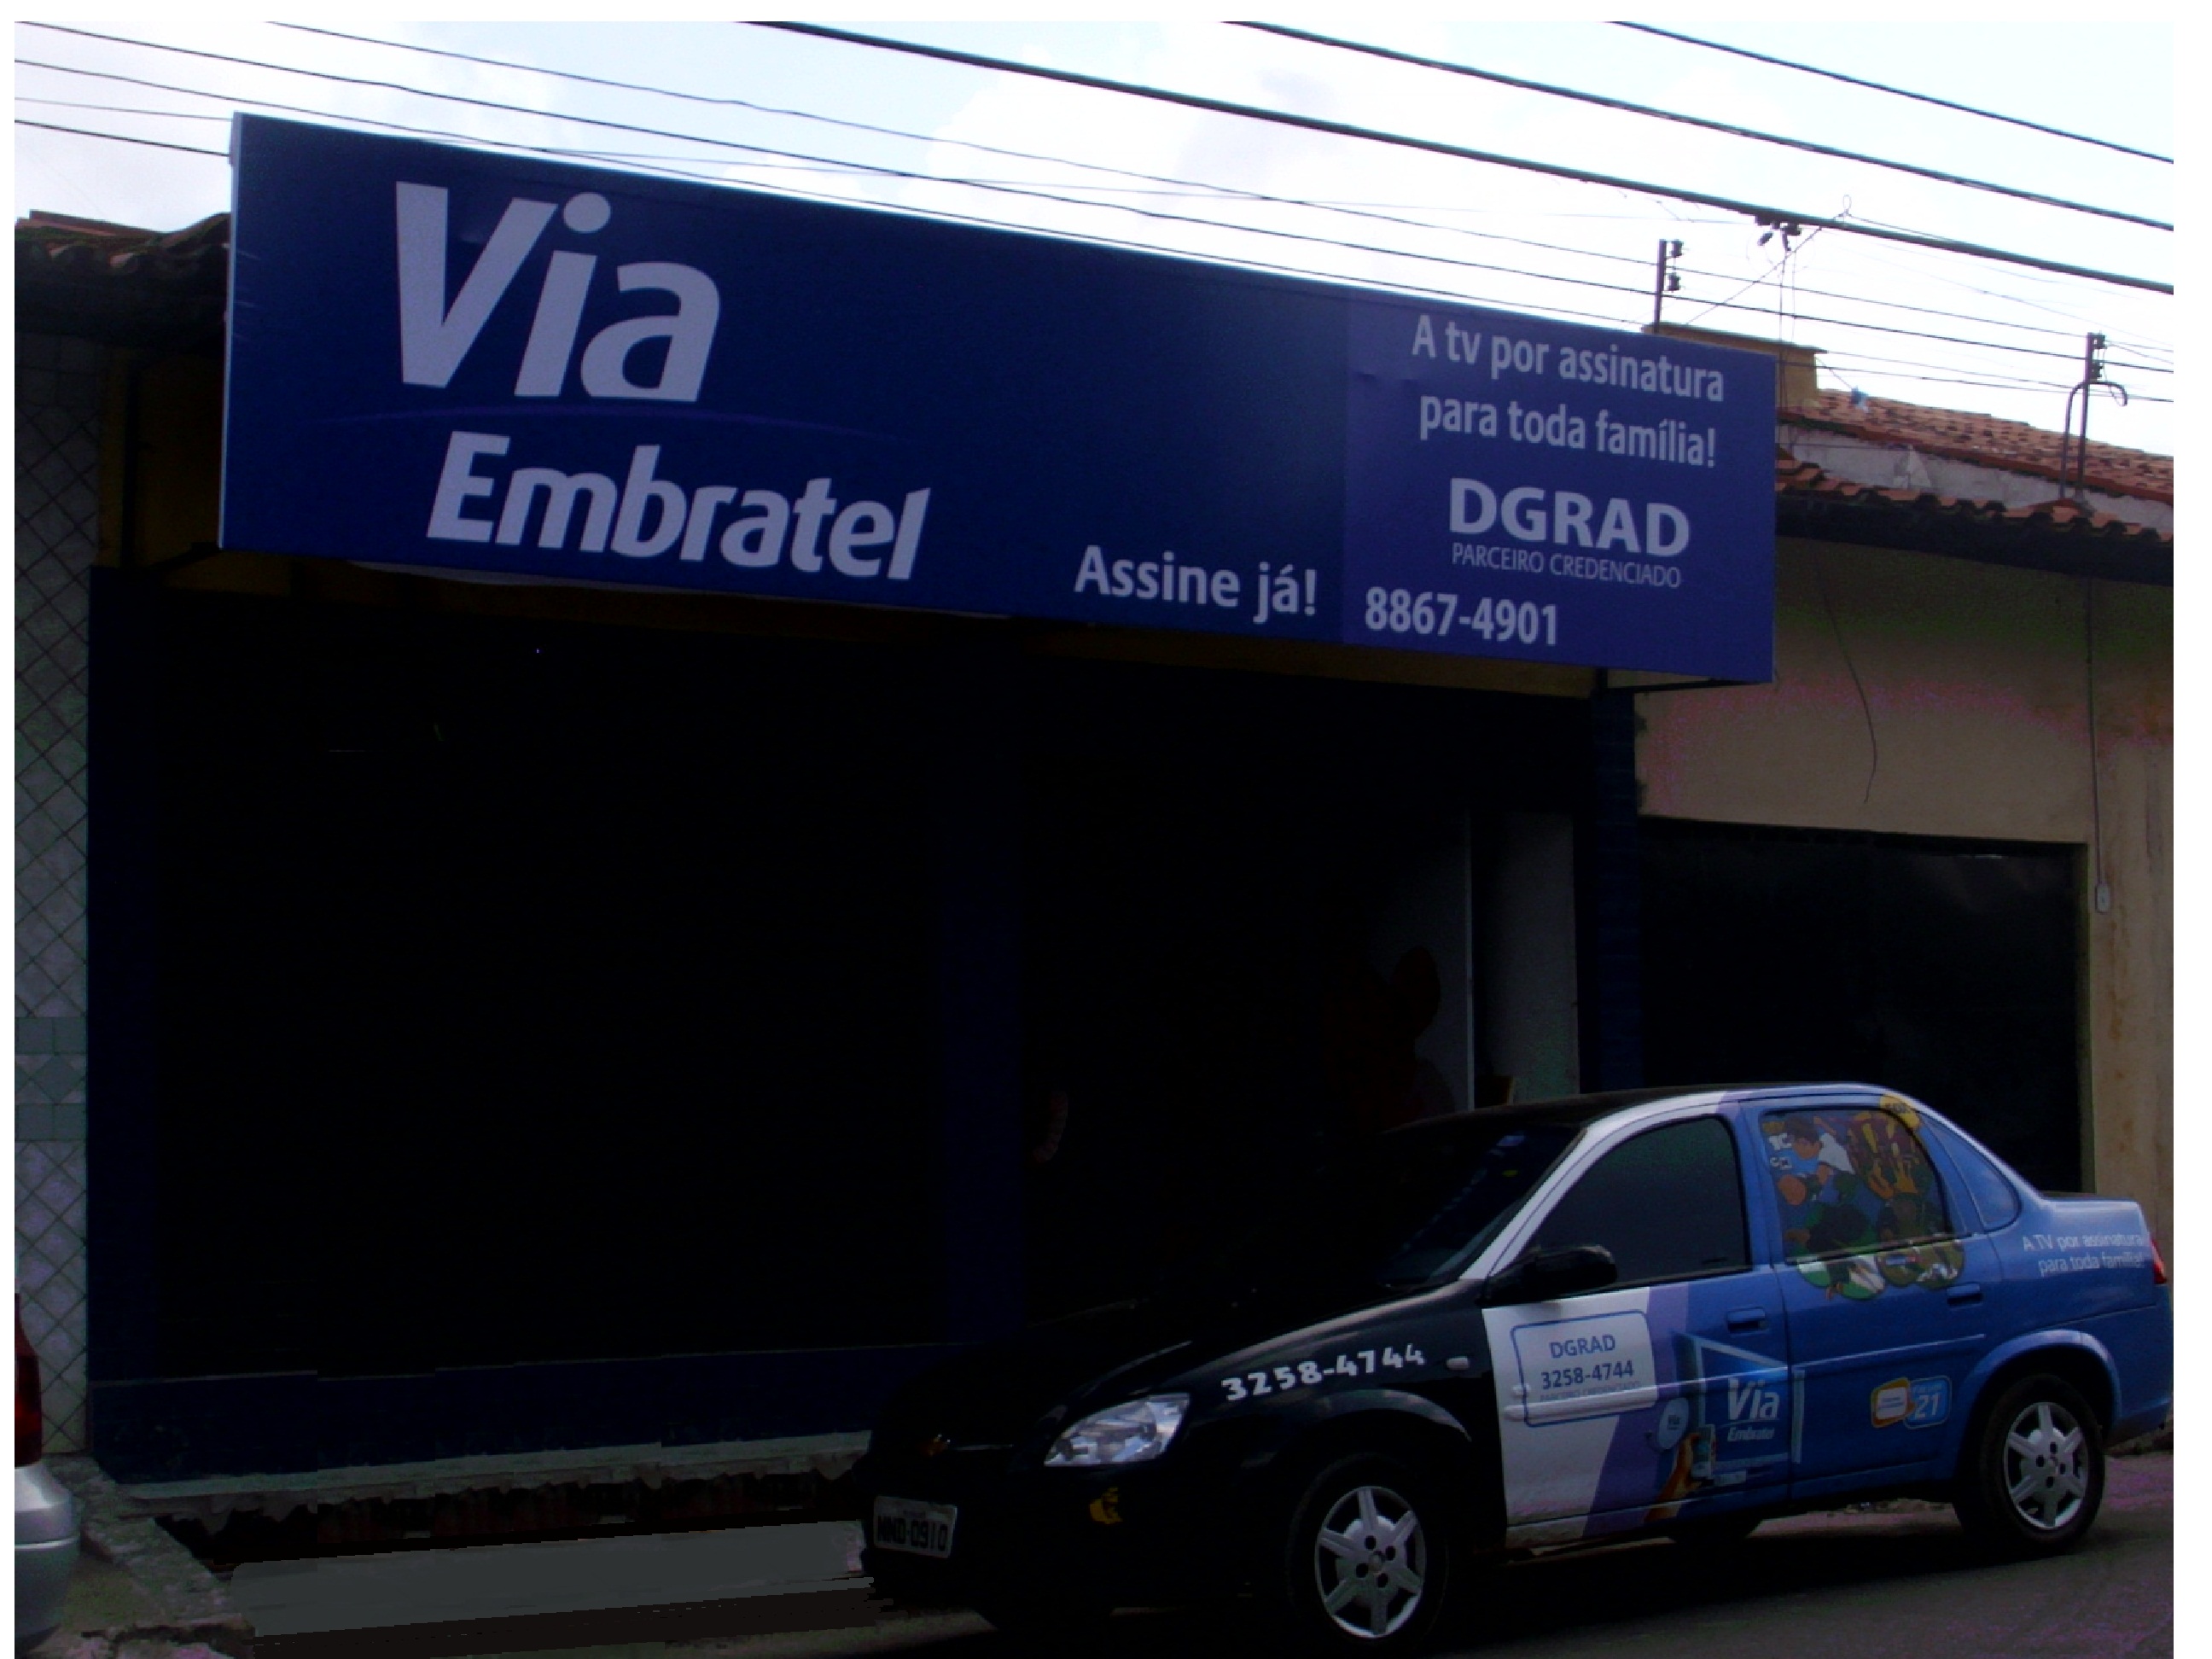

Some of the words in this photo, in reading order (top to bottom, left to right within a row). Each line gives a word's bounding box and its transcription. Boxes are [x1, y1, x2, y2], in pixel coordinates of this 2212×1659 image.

[395, 180, 722, 403] Via
[1412, 314, 1436, 358] A
[1445, 321, 1481, 364] tv
[1491, 335, 1550, 380] por
[1557, 344, 1725, 402] assinatura
[1419, 395, 1498, 441] para
[1507, 401, 1586, 450] toda
[1595, 409, 1716, 469] família!
[425, 429, 932, 581] Embratel
[1449, 477, 1691, 556] DGRAD
[1074, 544, 1242, 608] Assine
[1253, 560, 1318, 625] já!
[1452, 542, 1545, 573] PARCEIRO
[1549, 553, 1682, 590] CREDENCIADO
[1365, 585, 1558, 647] 8867-4901
[2023, 1236, 2034, 1252] A
[2033, 1234, 2054, 1249] TV
[2057, 1236, 2079, 1252] por
[2038, 1258, 2069, 1278] para
[2070, 1253, 2100, 1272] toda
[1220, 1342, 1427, 1401] 3258-4744
[1540, 1359, 1635, 1390] 3258-4744
[1549, 1334, 1616, 1359] DGRAD
[1727, 1377, 1780, 1421] Via
[1914, 1392, 1940, 1419] 21
